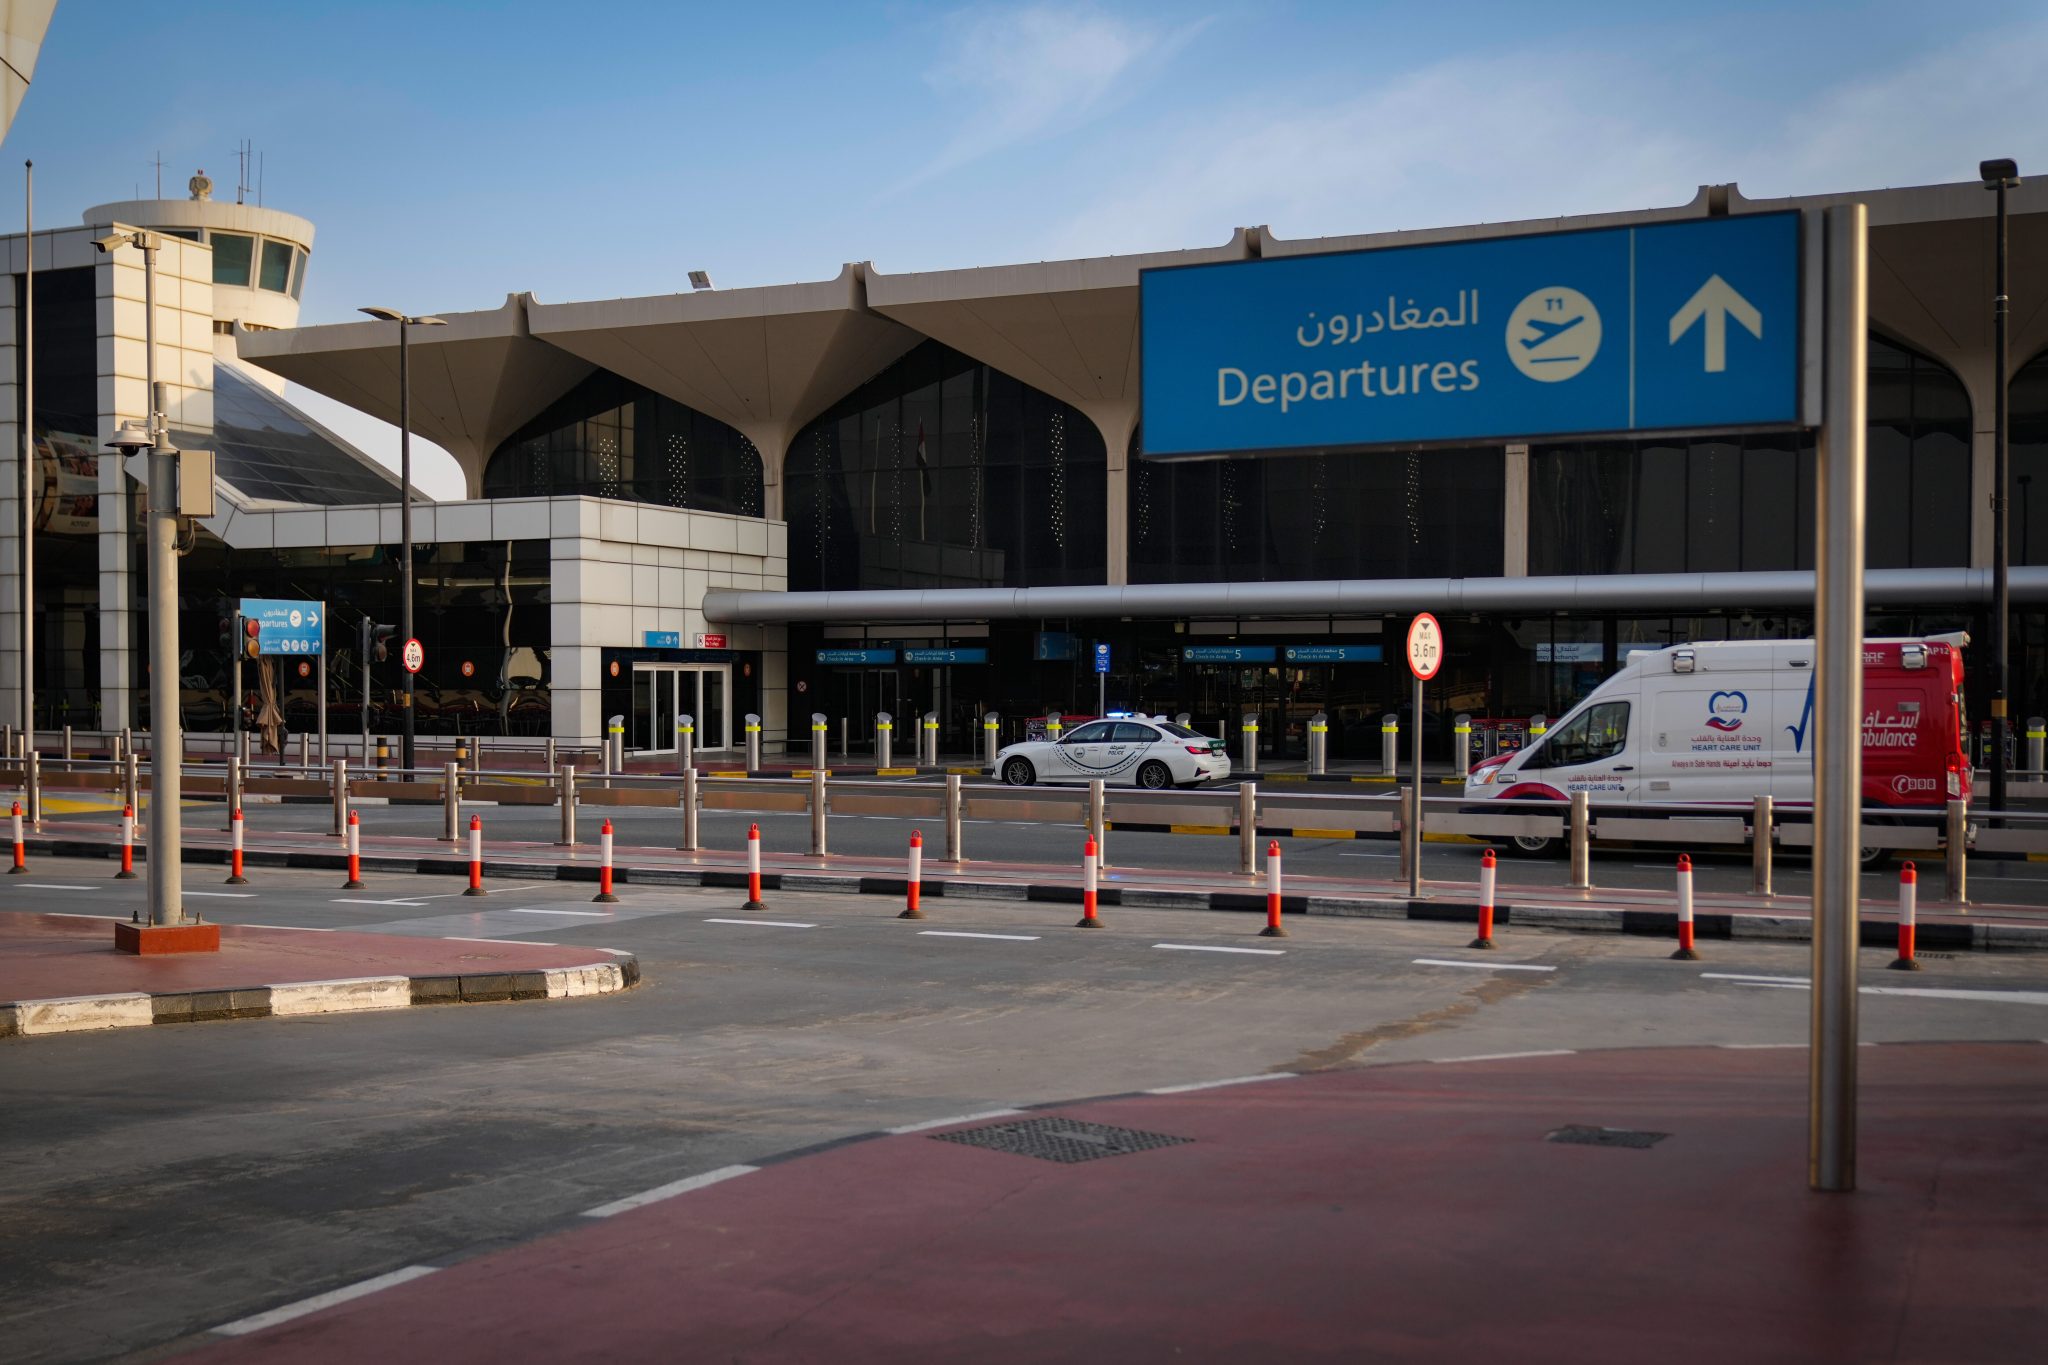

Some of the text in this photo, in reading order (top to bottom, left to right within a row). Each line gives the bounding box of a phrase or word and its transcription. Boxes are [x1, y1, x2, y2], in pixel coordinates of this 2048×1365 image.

[1545, 298, 1563, 311] T1
[1297, 289, 1479, 347] المغادرون
[1217, 359, 1480, 413] Departures
[259, 619, 288, 629] partures
[1235, 649, 1241, 659] 5
[1338, 648, 1345, 659] 5
[1413, 643, 1437, 658] 3.6m
[406, 654, 421, 662] 4.6m
[861, 651, 867, 661] 5
[949, 651, 955, 661] 5
[1672, 760, 1689, 769] Always
[1695, 759, 1705, 768] Safe
[1706, 760, 1721, 768] Hands
[1568, 783, 1621, 791] HEART CARE UNIT
[1909, 779, 1936, 790] 998
